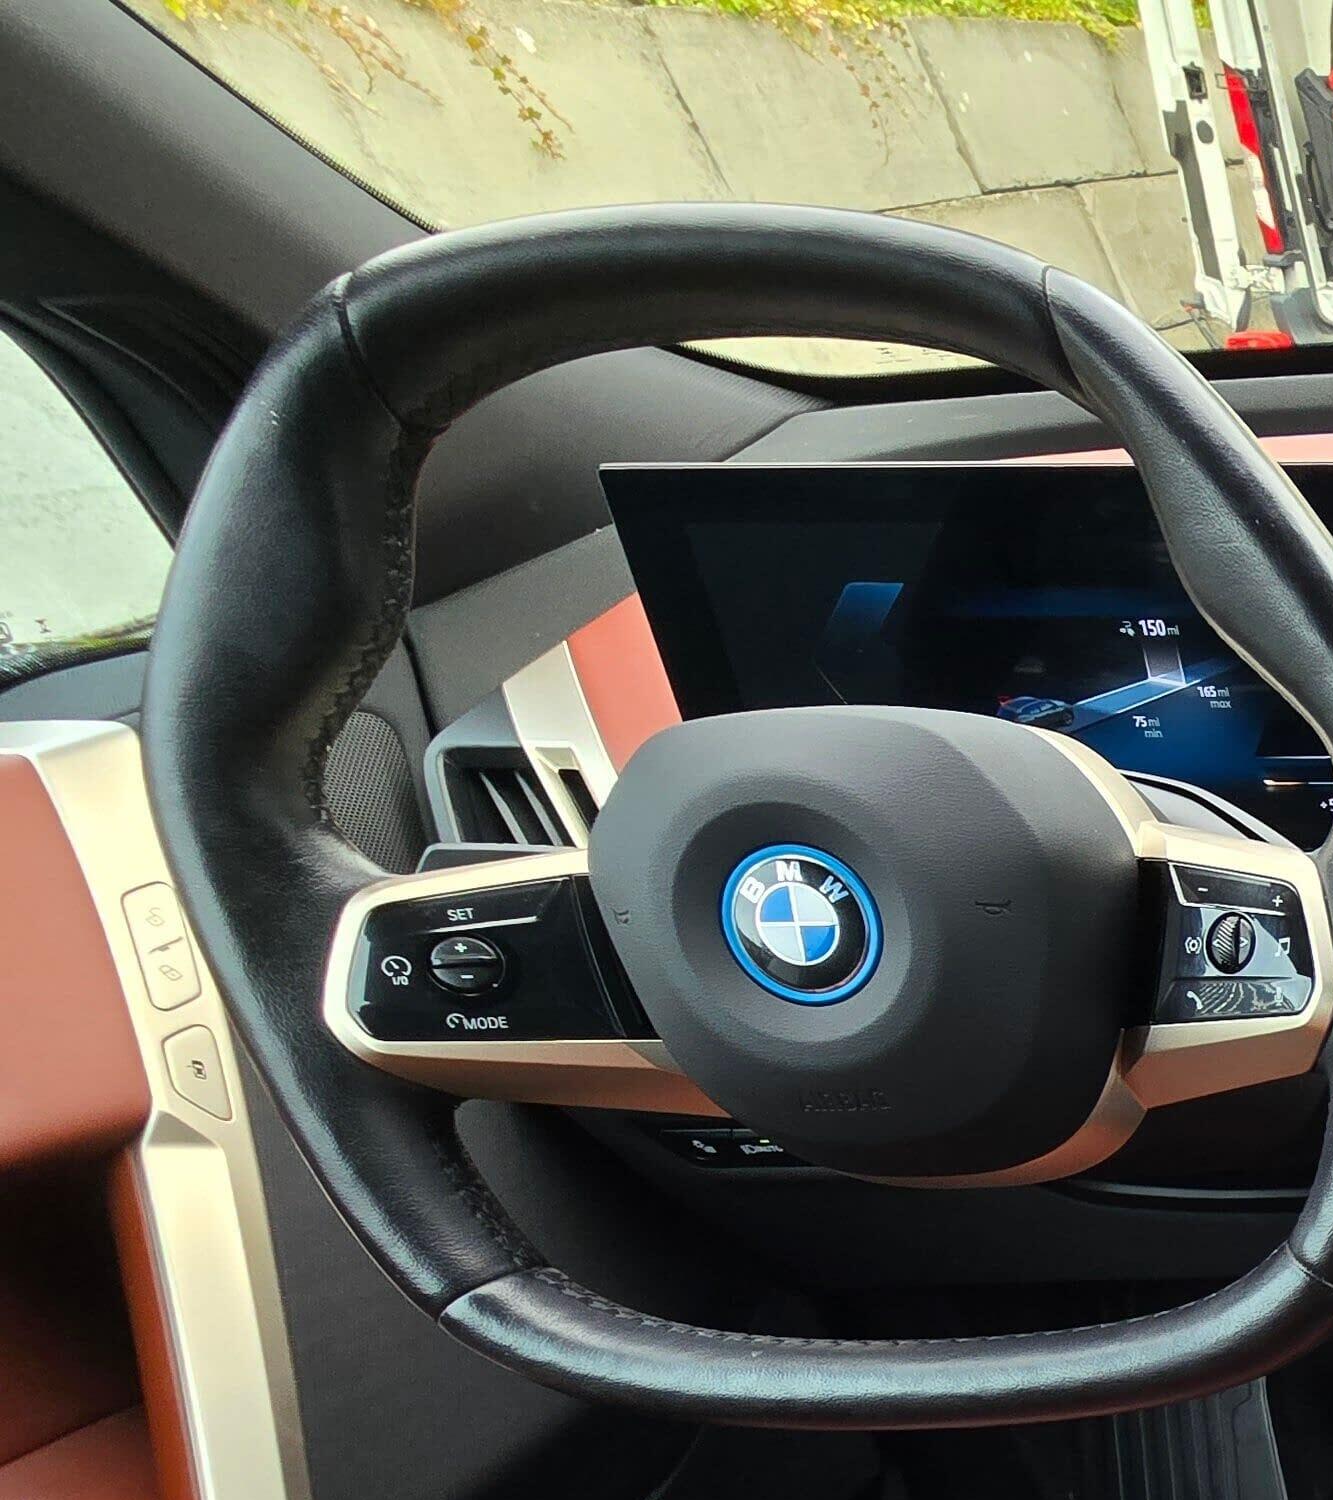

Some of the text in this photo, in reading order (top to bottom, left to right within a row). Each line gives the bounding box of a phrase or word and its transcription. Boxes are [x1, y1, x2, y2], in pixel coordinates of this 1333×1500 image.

[1138, 619, 1167, 637] 150
[1196, 685, 1217, 698] 165
[1210, 700, 1232, 709] max
[1132, 715, 1148, 728] 75
[1144, 728, 1164, 738] min
[739, 860, 849, 904] BMW
[447, 907, 474, 921] SET
[464, 1016, 509, 1030] MODE
